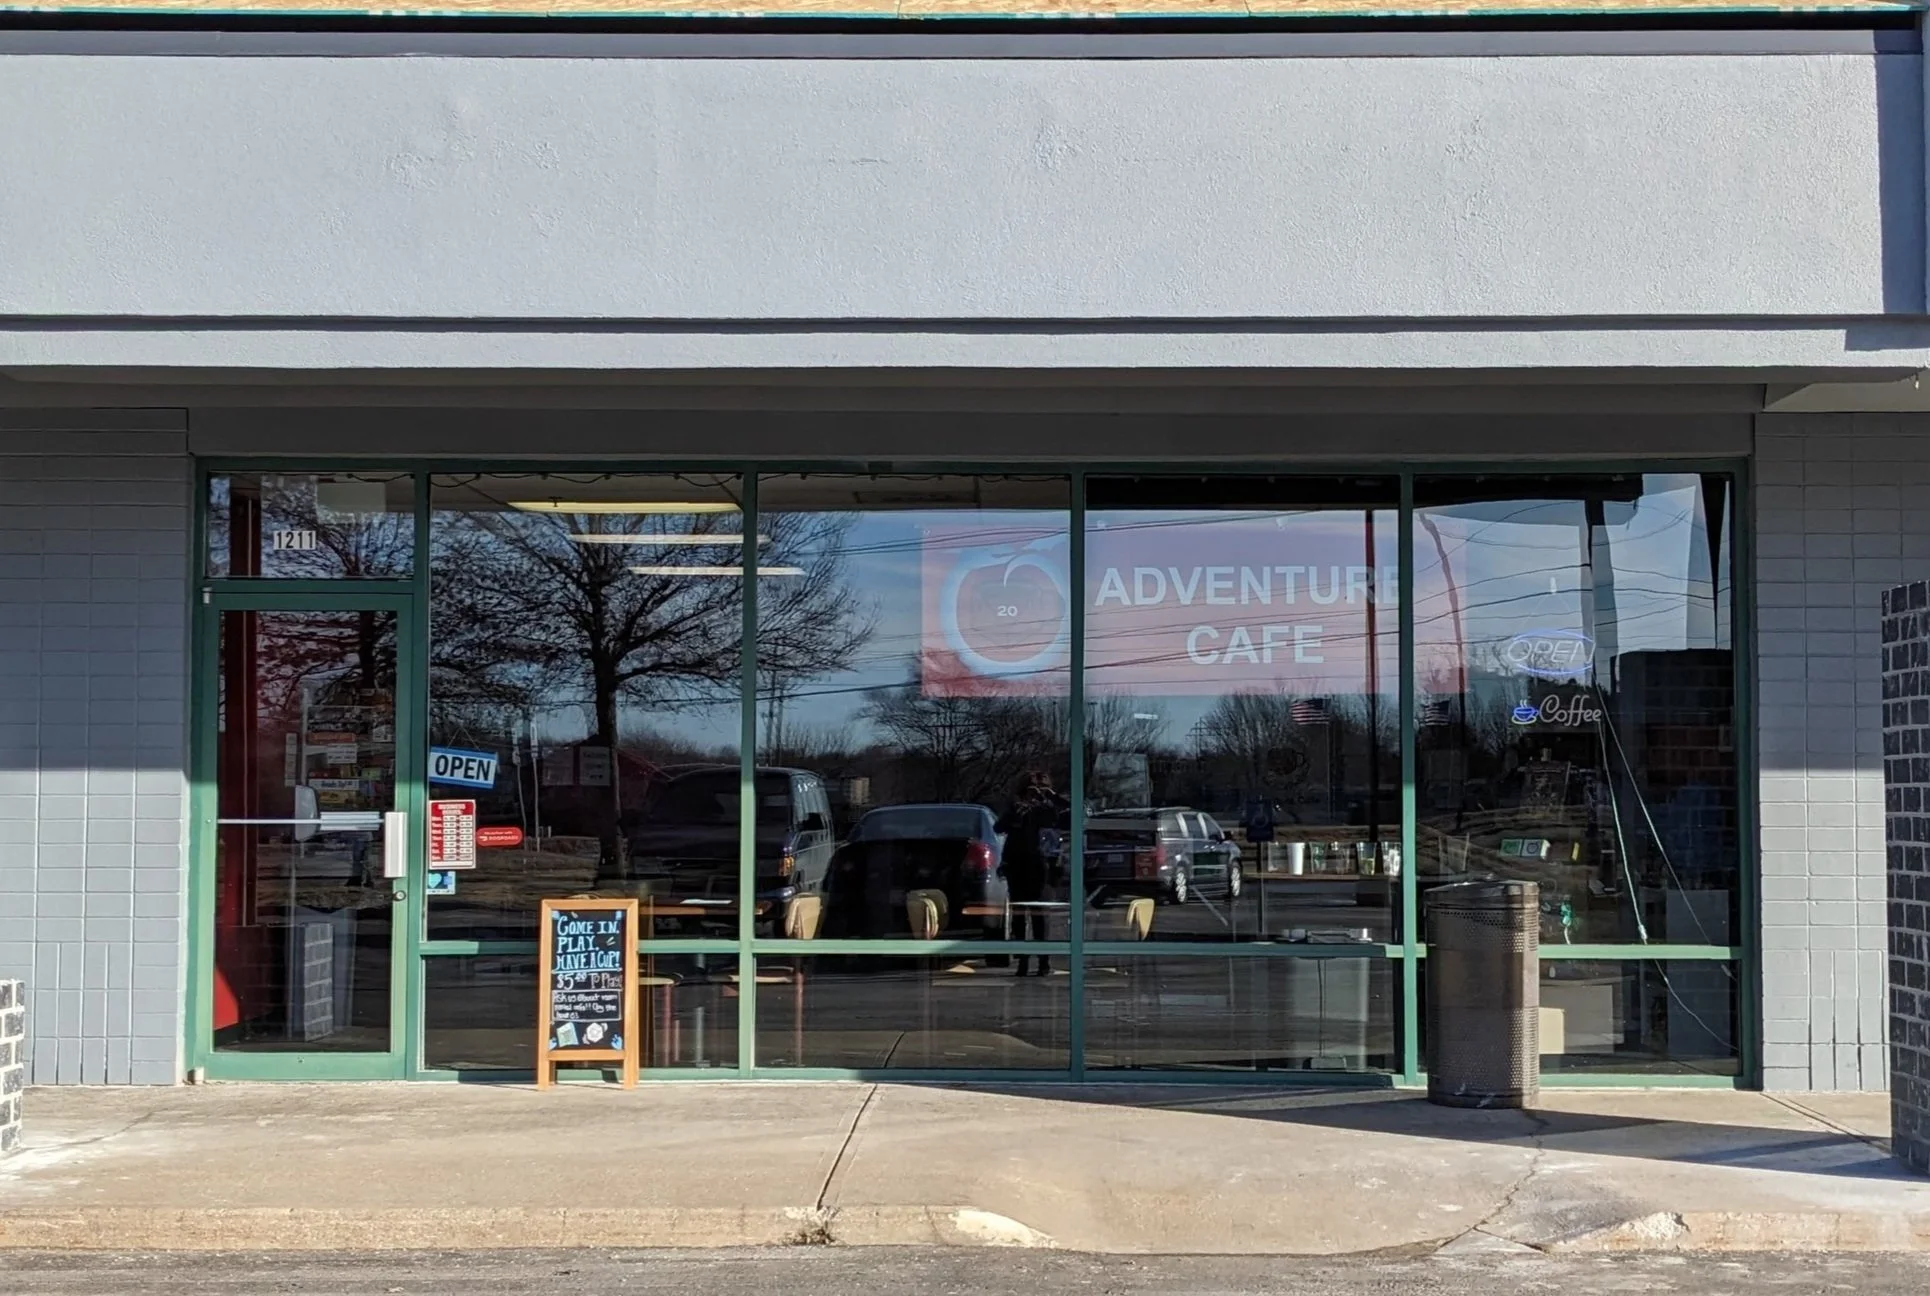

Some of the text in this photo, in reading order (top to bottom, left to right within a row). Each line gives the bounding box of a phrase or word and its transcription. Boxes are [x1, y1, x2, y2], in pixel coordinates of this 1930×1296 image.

[277, 531, 313, 549] 1211
[997, 605, 1018, 617] 20
[1187, 625, 1324, 665] CAFE
[1507, 639, 1597, 664] OPEN
[1539, 694, 1602, 727] Coffee
[435, 754, 491, 781] OPEN
[557, 916, 595, 936] COME
[556, 936, 599, 954] PLAY.
[555, 953, 589, 971] HAVE
[590, 952, 597, 968] A
